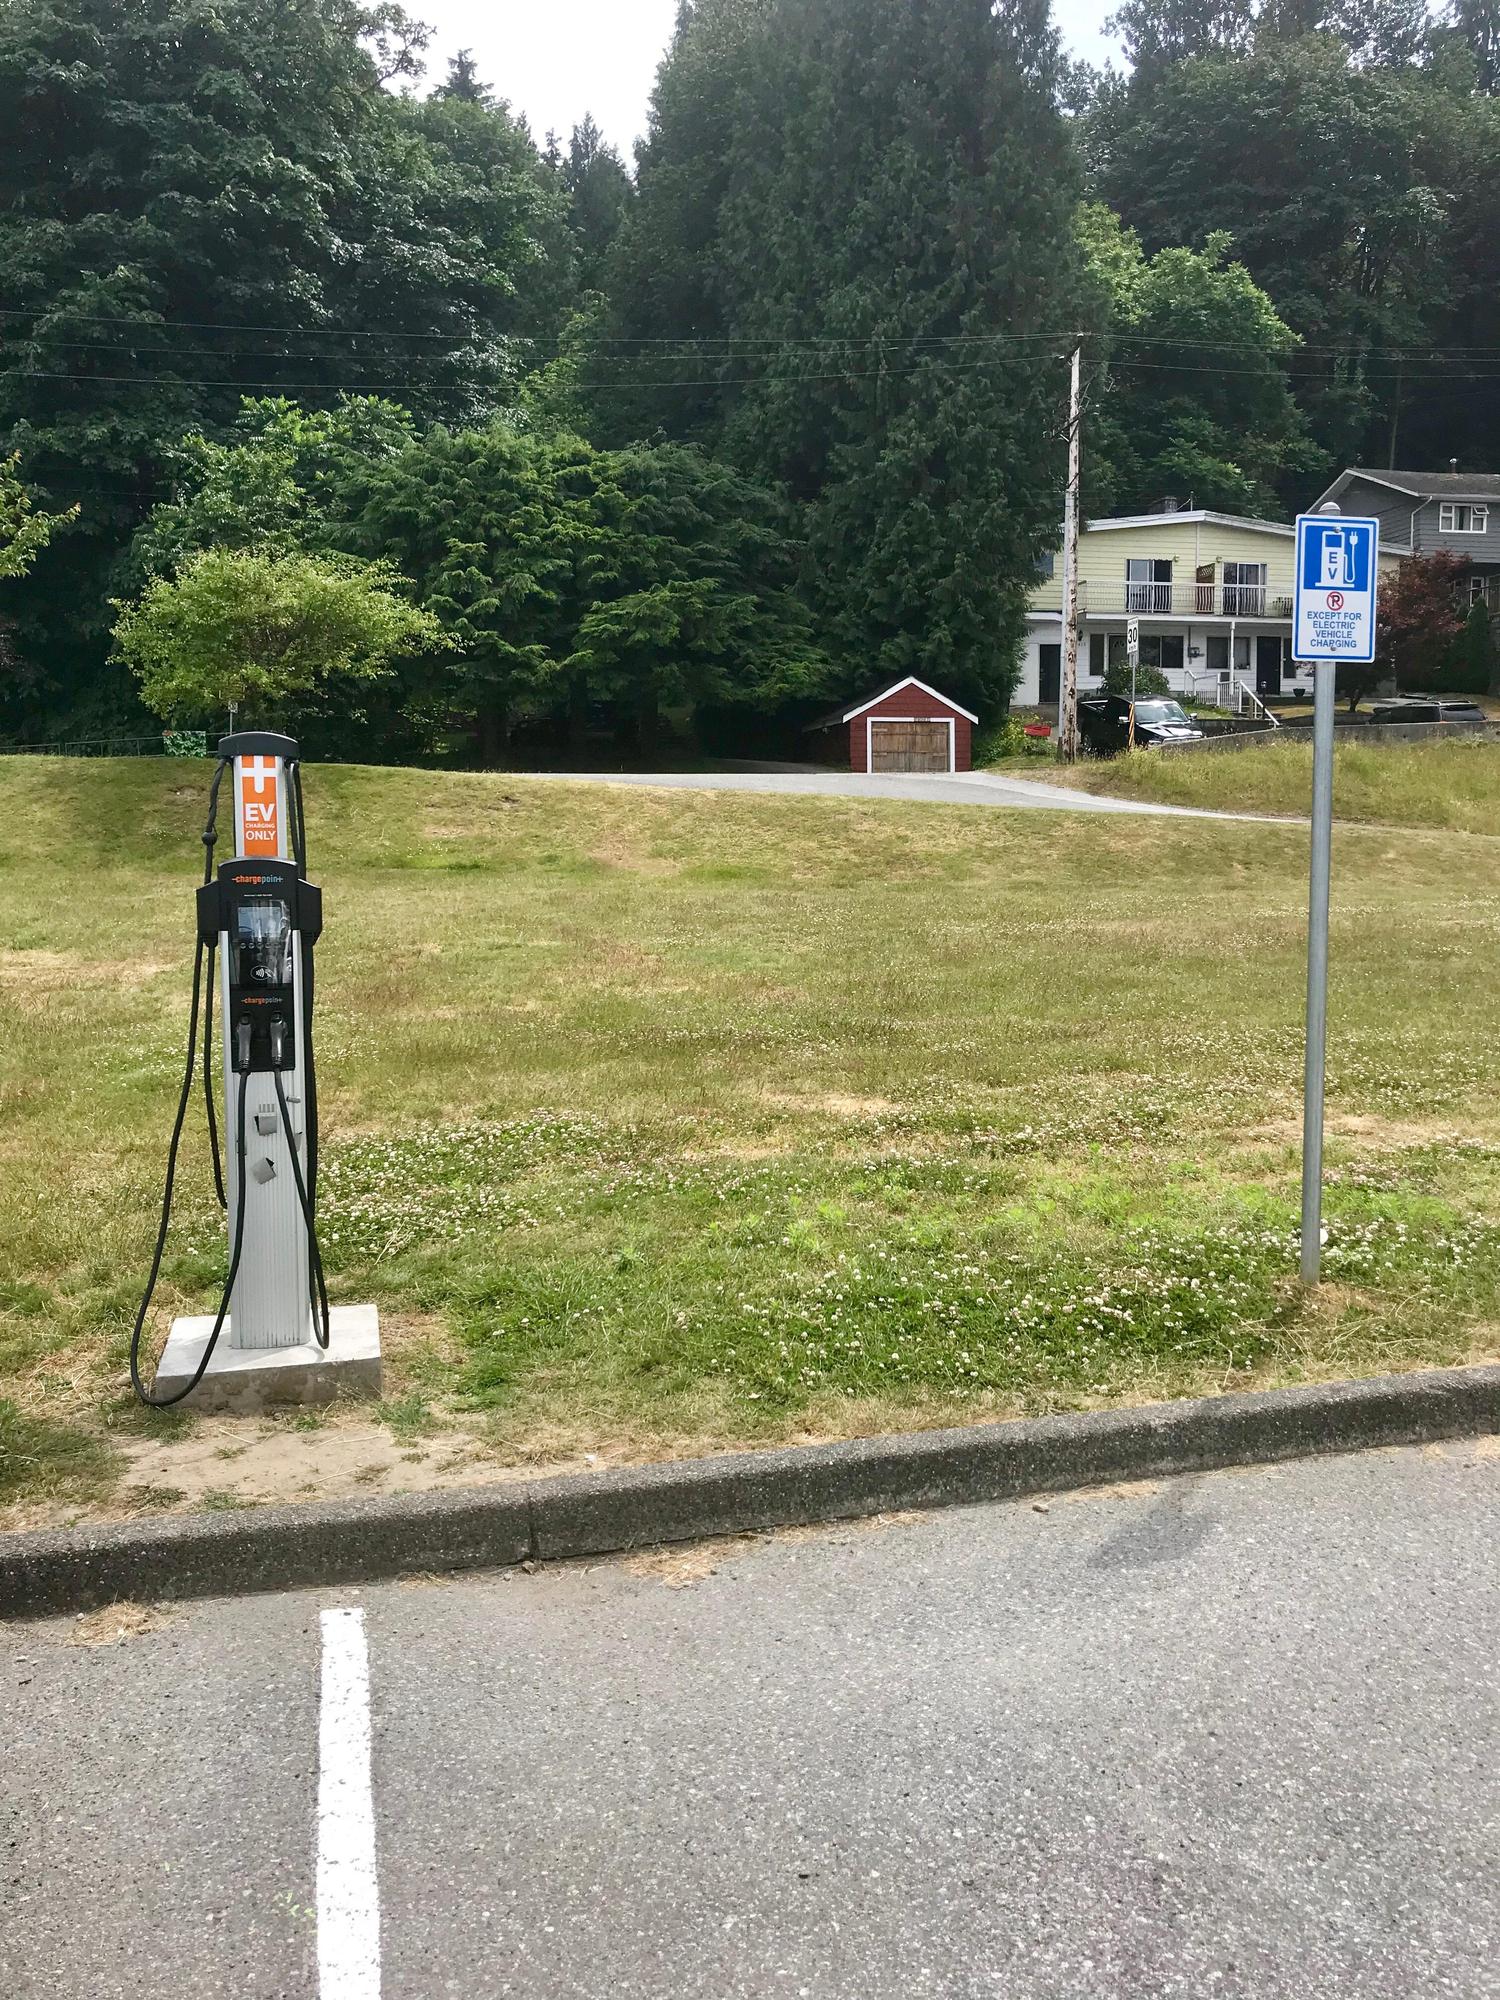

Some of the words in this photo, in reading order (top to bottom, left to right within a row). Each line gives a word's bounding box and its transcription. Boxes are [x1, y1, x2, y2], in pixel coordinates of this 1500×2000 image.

[1307, 611, 1341, 620] EXCEPT
[1344, 612, 1361, 621] FOR
[1313, 621, 1356, 629] ELECTRIC
[1128, 627, 1137, 644] 30
[1315, 630, 1352, 638] VEHICLE
[1310, 639, 1357, 648] CHARGING
[245, 803, 275, 821] EV
[246, 831, 276, 840] ONLY
